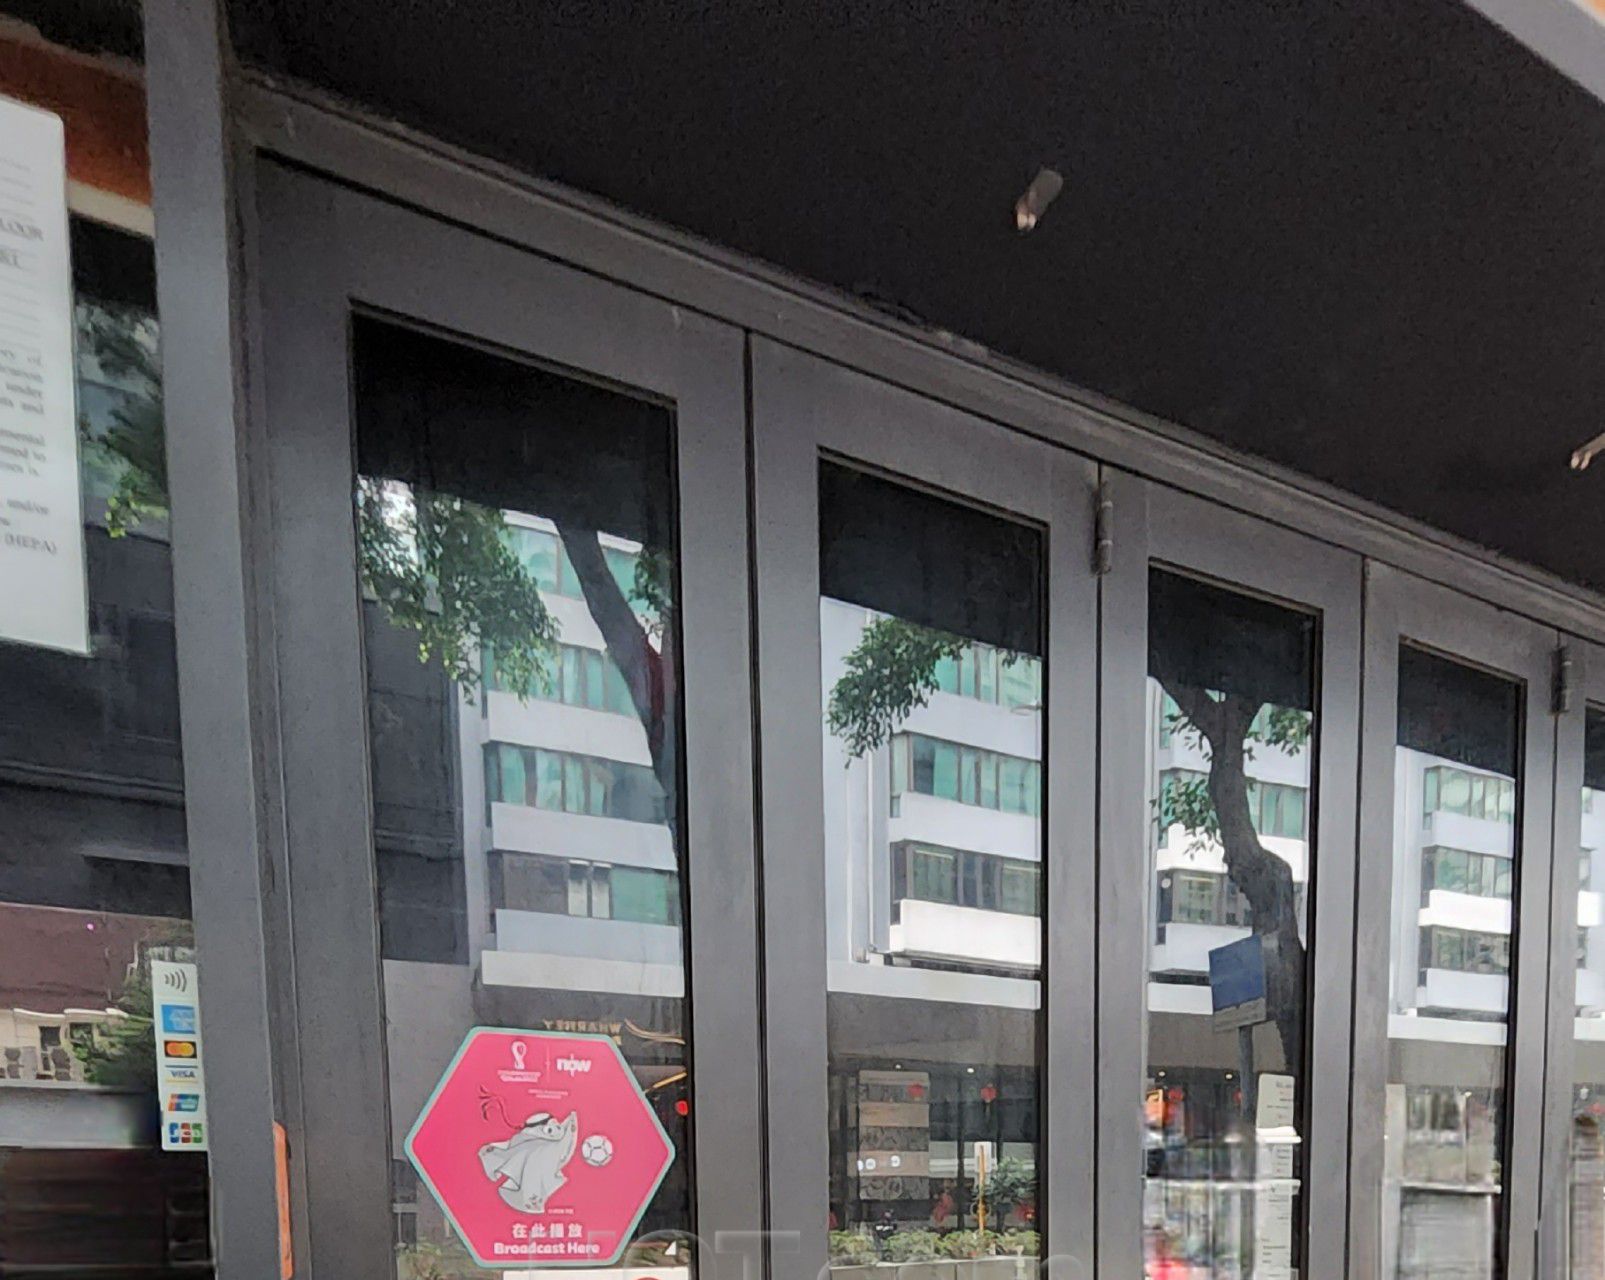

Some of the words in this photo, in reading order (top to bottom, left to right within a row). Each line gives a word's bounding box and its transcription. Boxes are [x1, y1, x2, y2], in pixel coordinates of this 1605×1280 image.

[512, 1223, 583, 1239] 在此播放
[494, 1242, 566, 1255] Broadcast
[567, 1242, 601, 1255] Here
